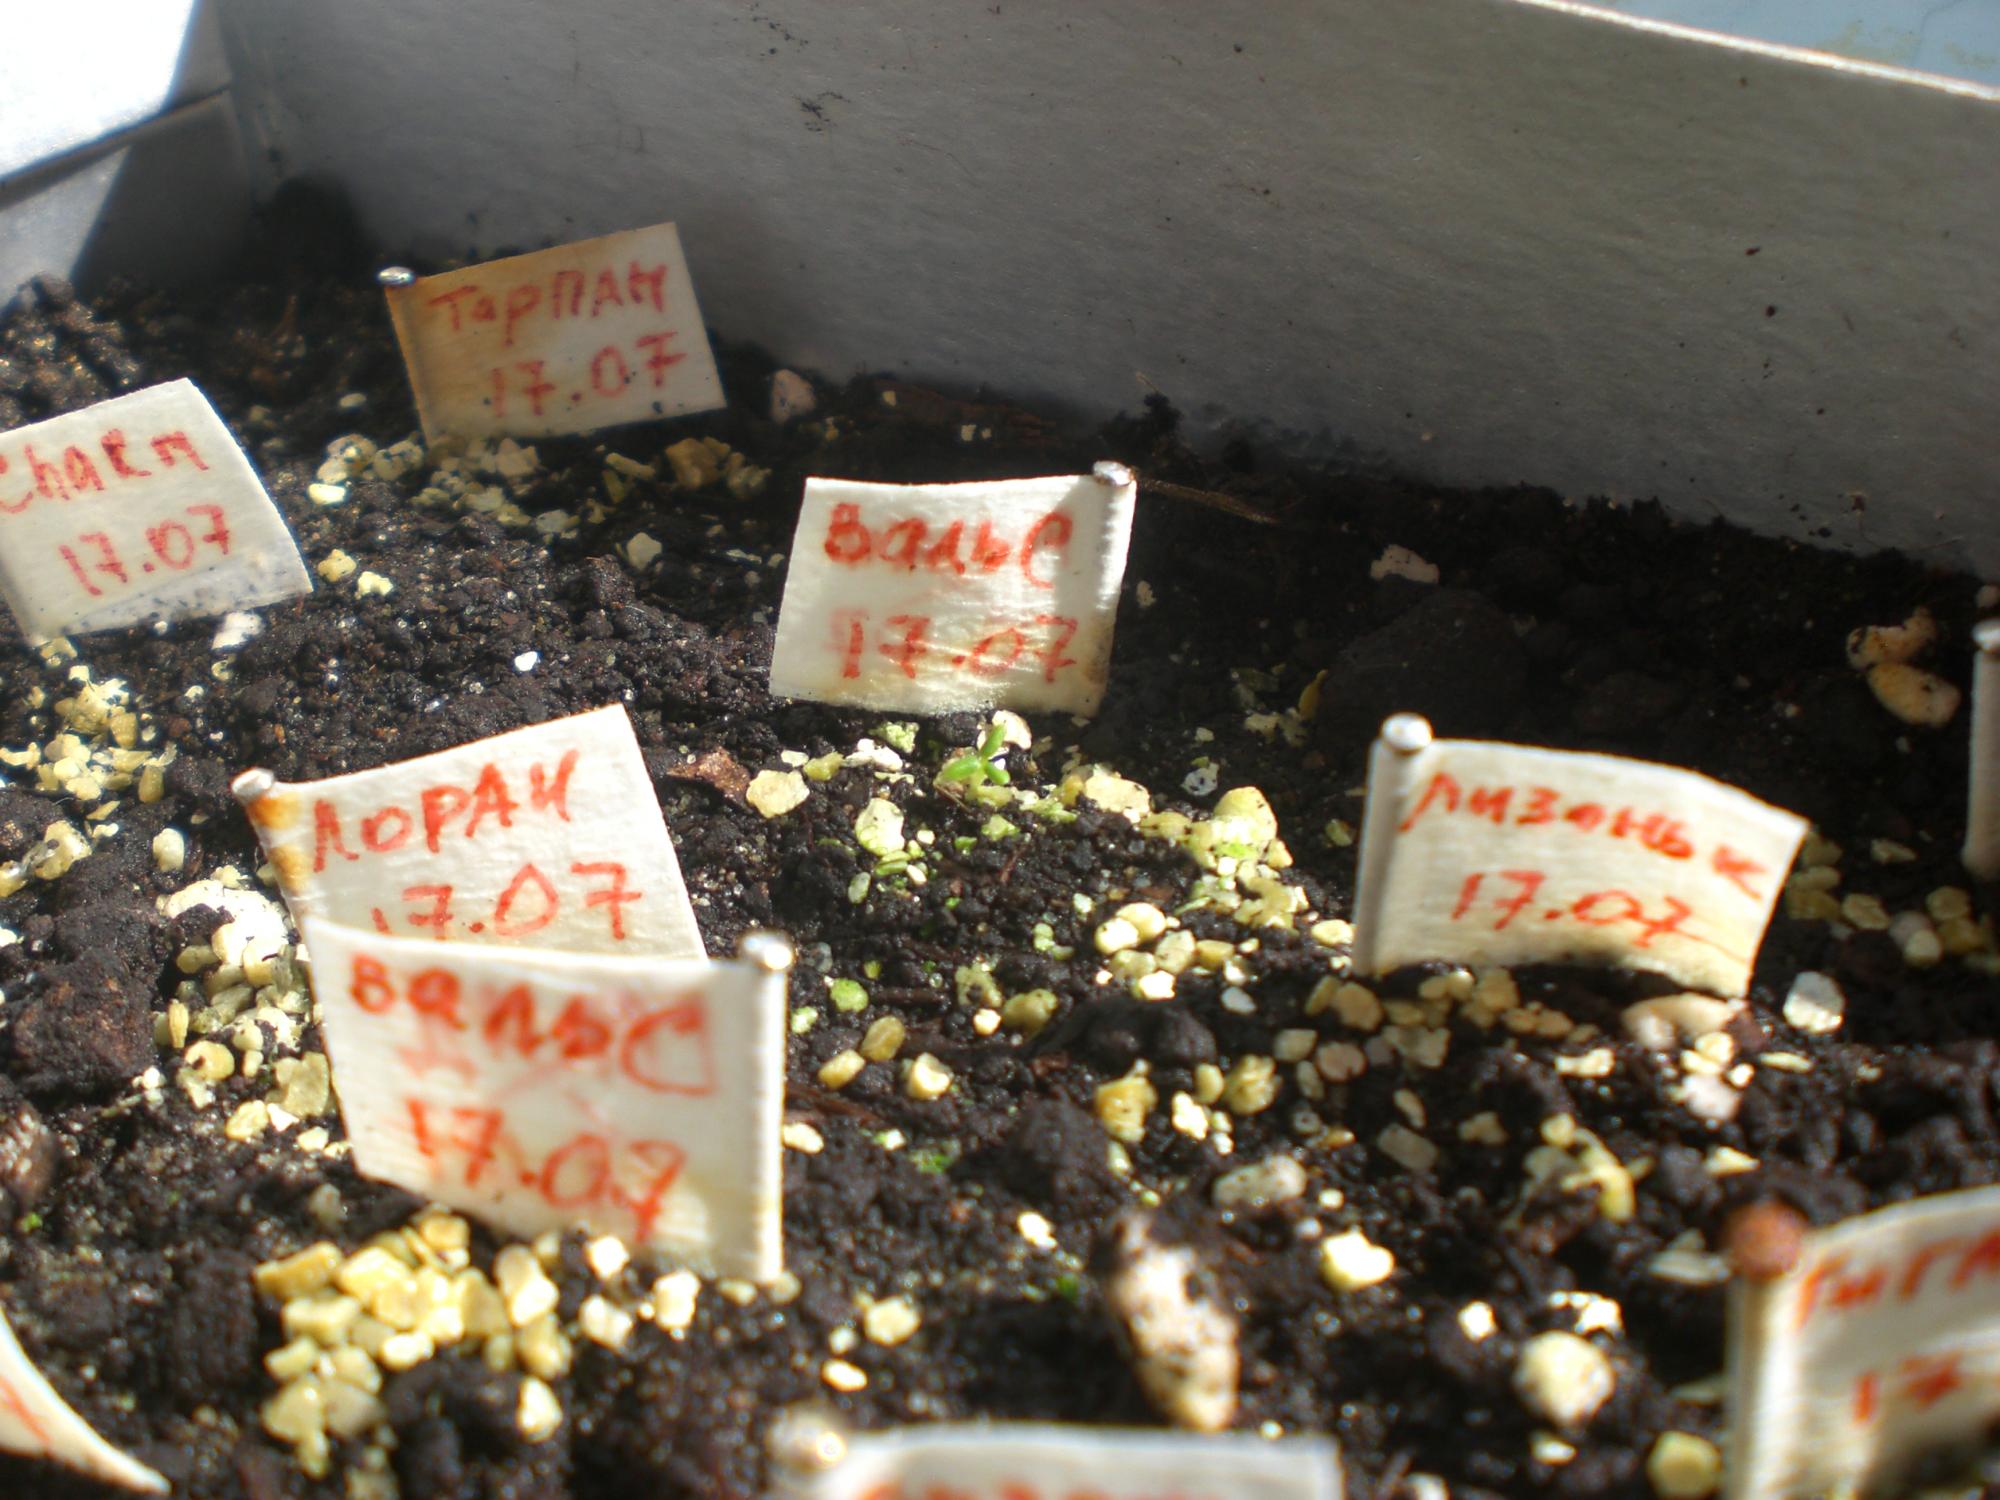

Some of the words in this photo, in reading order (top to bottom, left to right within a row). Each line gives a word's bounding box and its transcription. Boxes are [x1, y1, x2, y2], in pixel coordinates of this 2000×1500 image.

[489, 331, 687, 418] 17.07
[59, 504, 230, 596] 17.07
[843, 613, 1078, 683] 17.07
[1452, 871, 1691, 949] 17.07
[404, 1098, 688, 1243] 17.07
